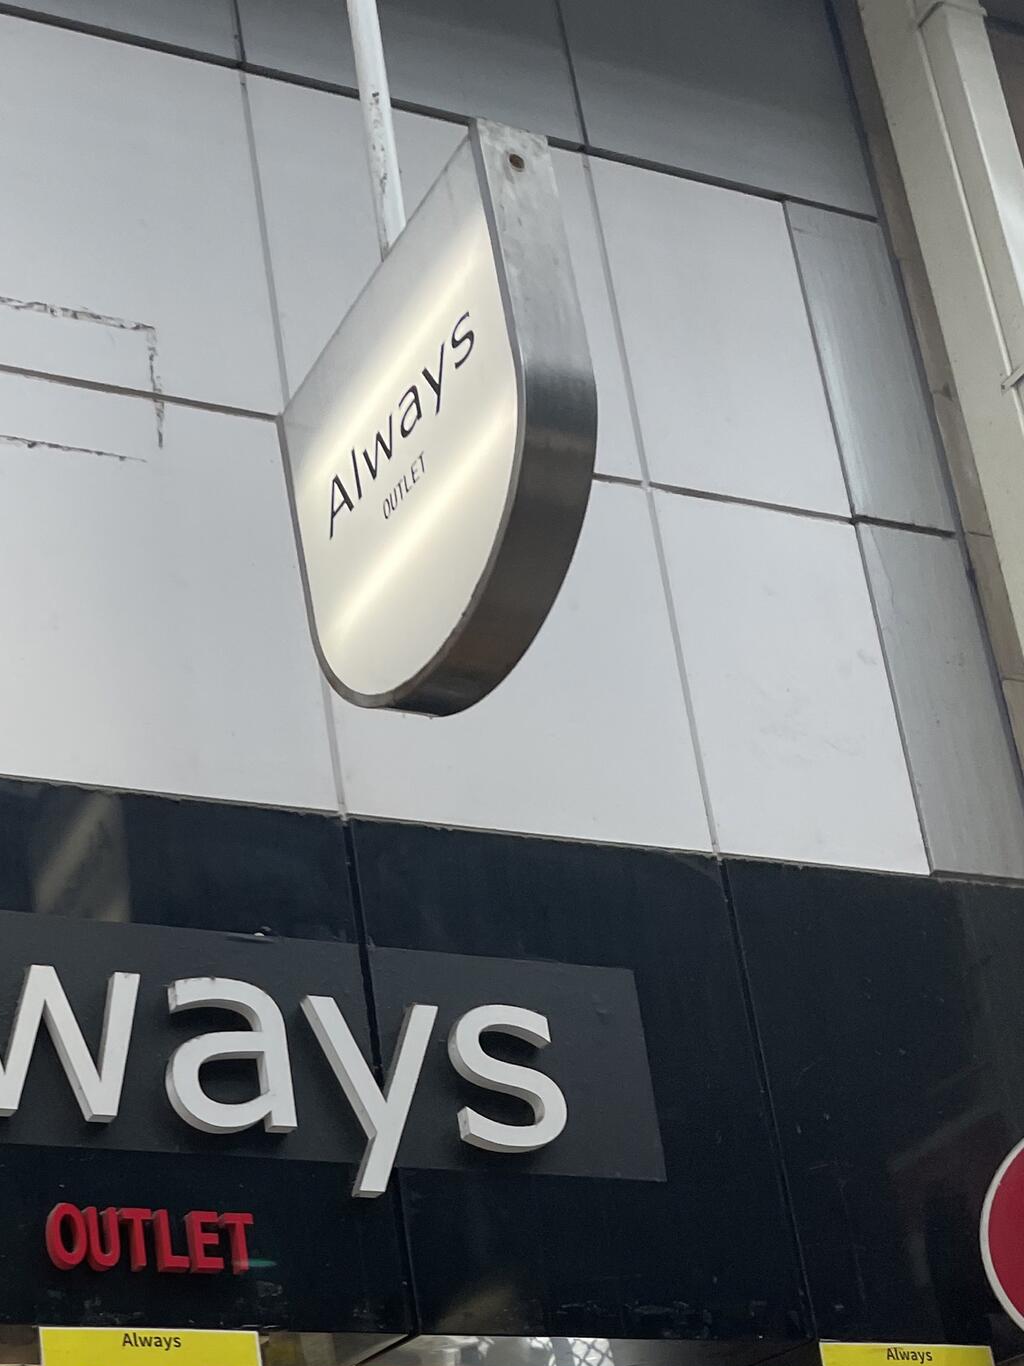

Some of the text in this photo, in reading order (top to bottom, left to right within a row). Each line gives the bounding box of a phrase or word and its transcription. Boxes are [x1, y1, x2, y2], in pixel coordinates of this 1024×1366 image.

[329, 311, 475, 540] Always
[383, 451, 427, 520] OUTLET
[45, 1202, 254, 1274] OUTLET
[122, 1332, 182, 1350] Always
[886, 1348, 933, 1364] Always
